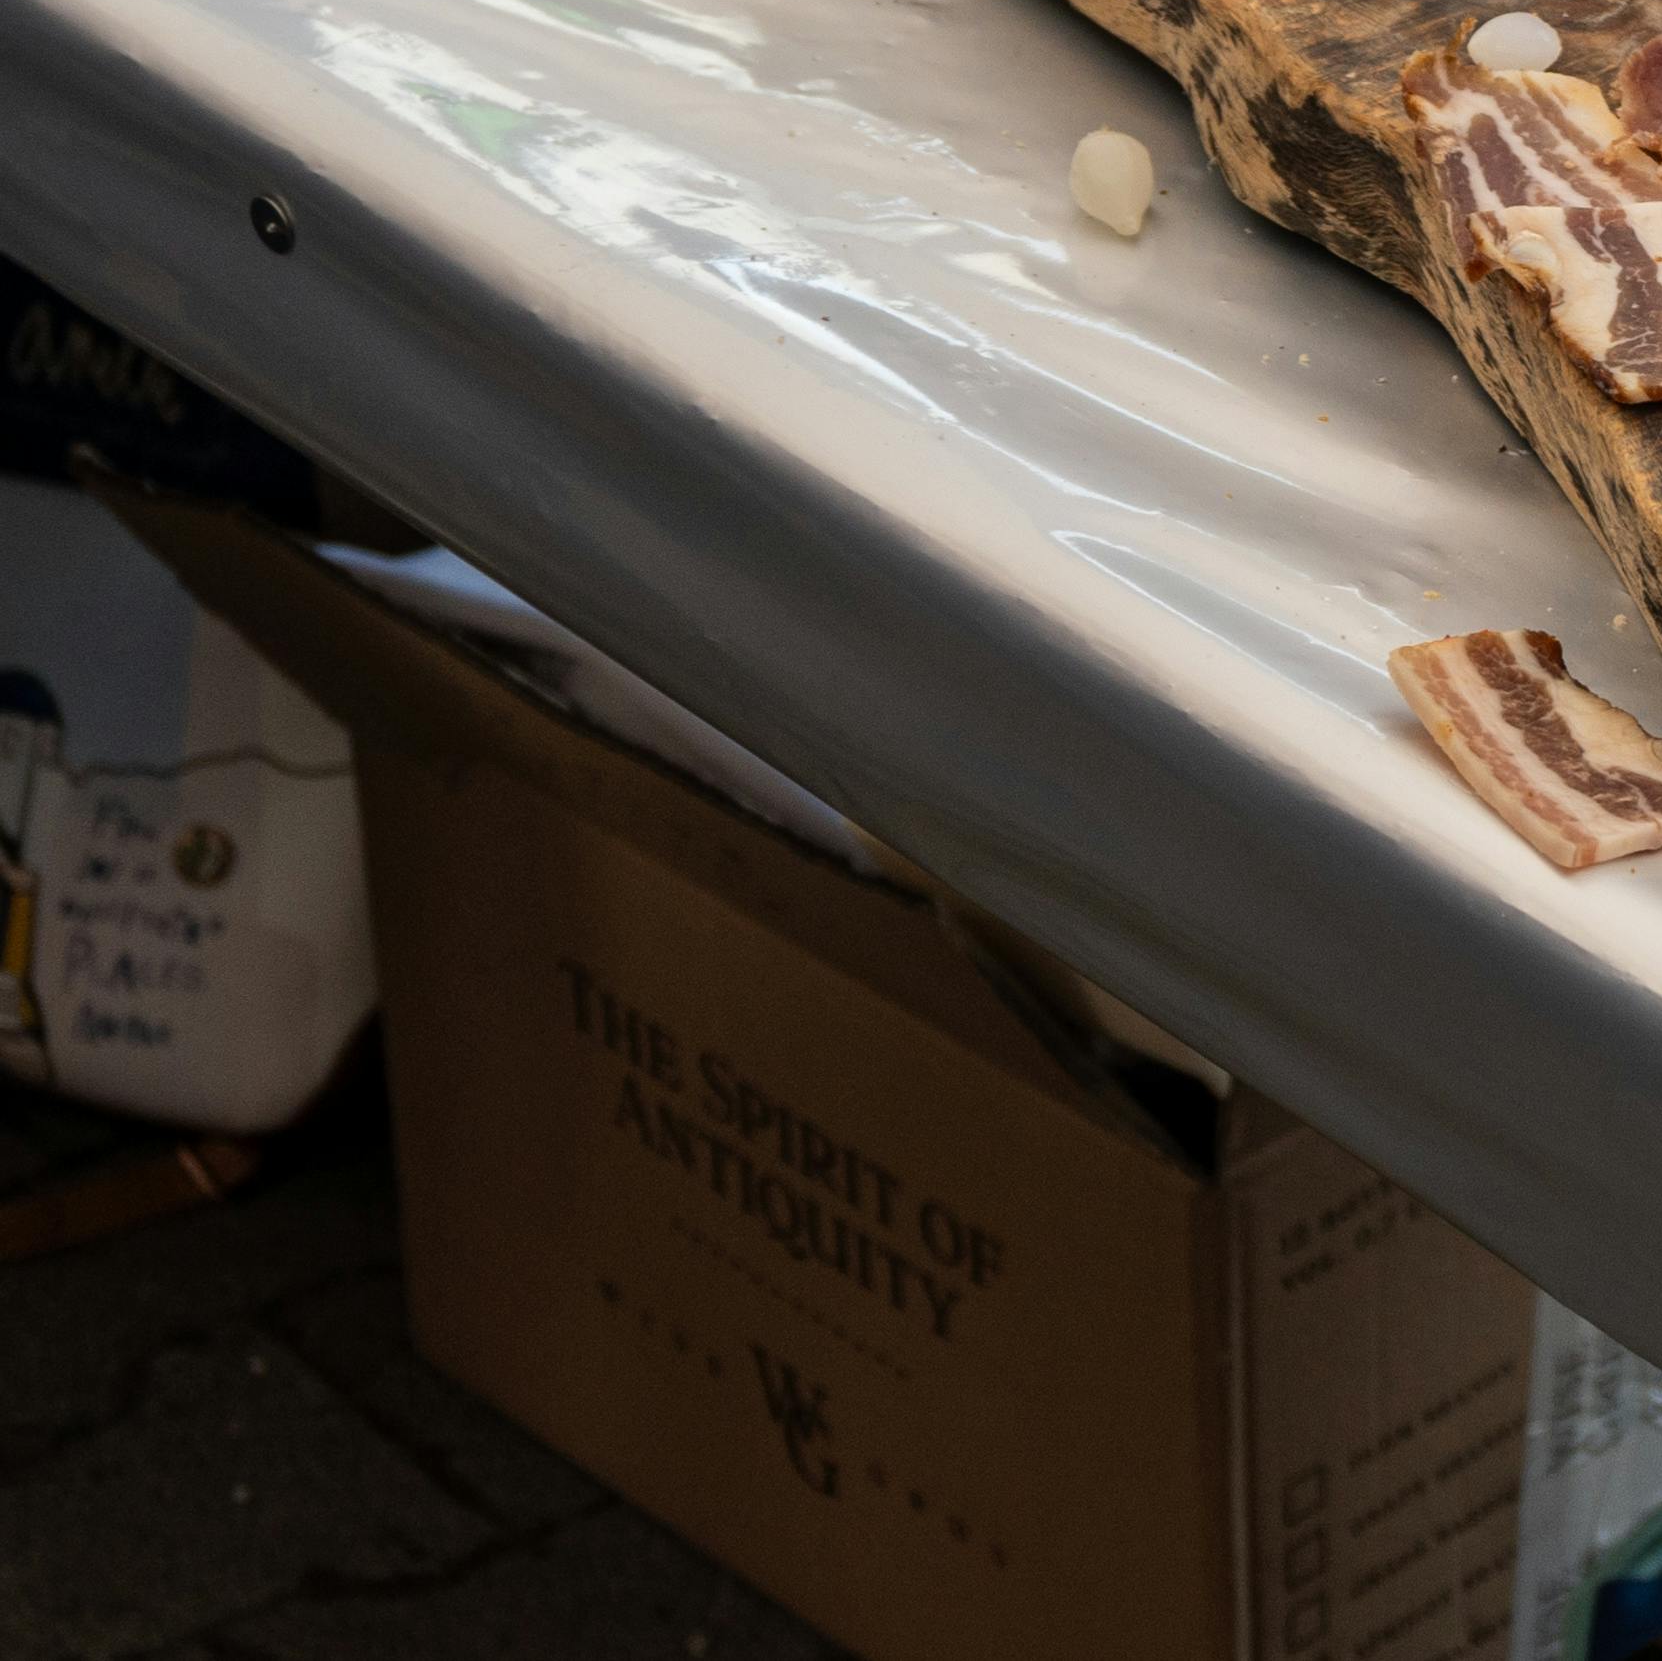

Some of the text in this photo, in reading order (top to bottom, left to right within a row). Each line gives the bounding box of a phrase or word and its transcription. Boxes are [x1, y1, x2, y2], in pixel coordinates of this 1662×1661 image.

[560, 958, 1007, 1290] THE SPIRIT OF
[617, 1074, 962, 1342] ANTIQUITY
